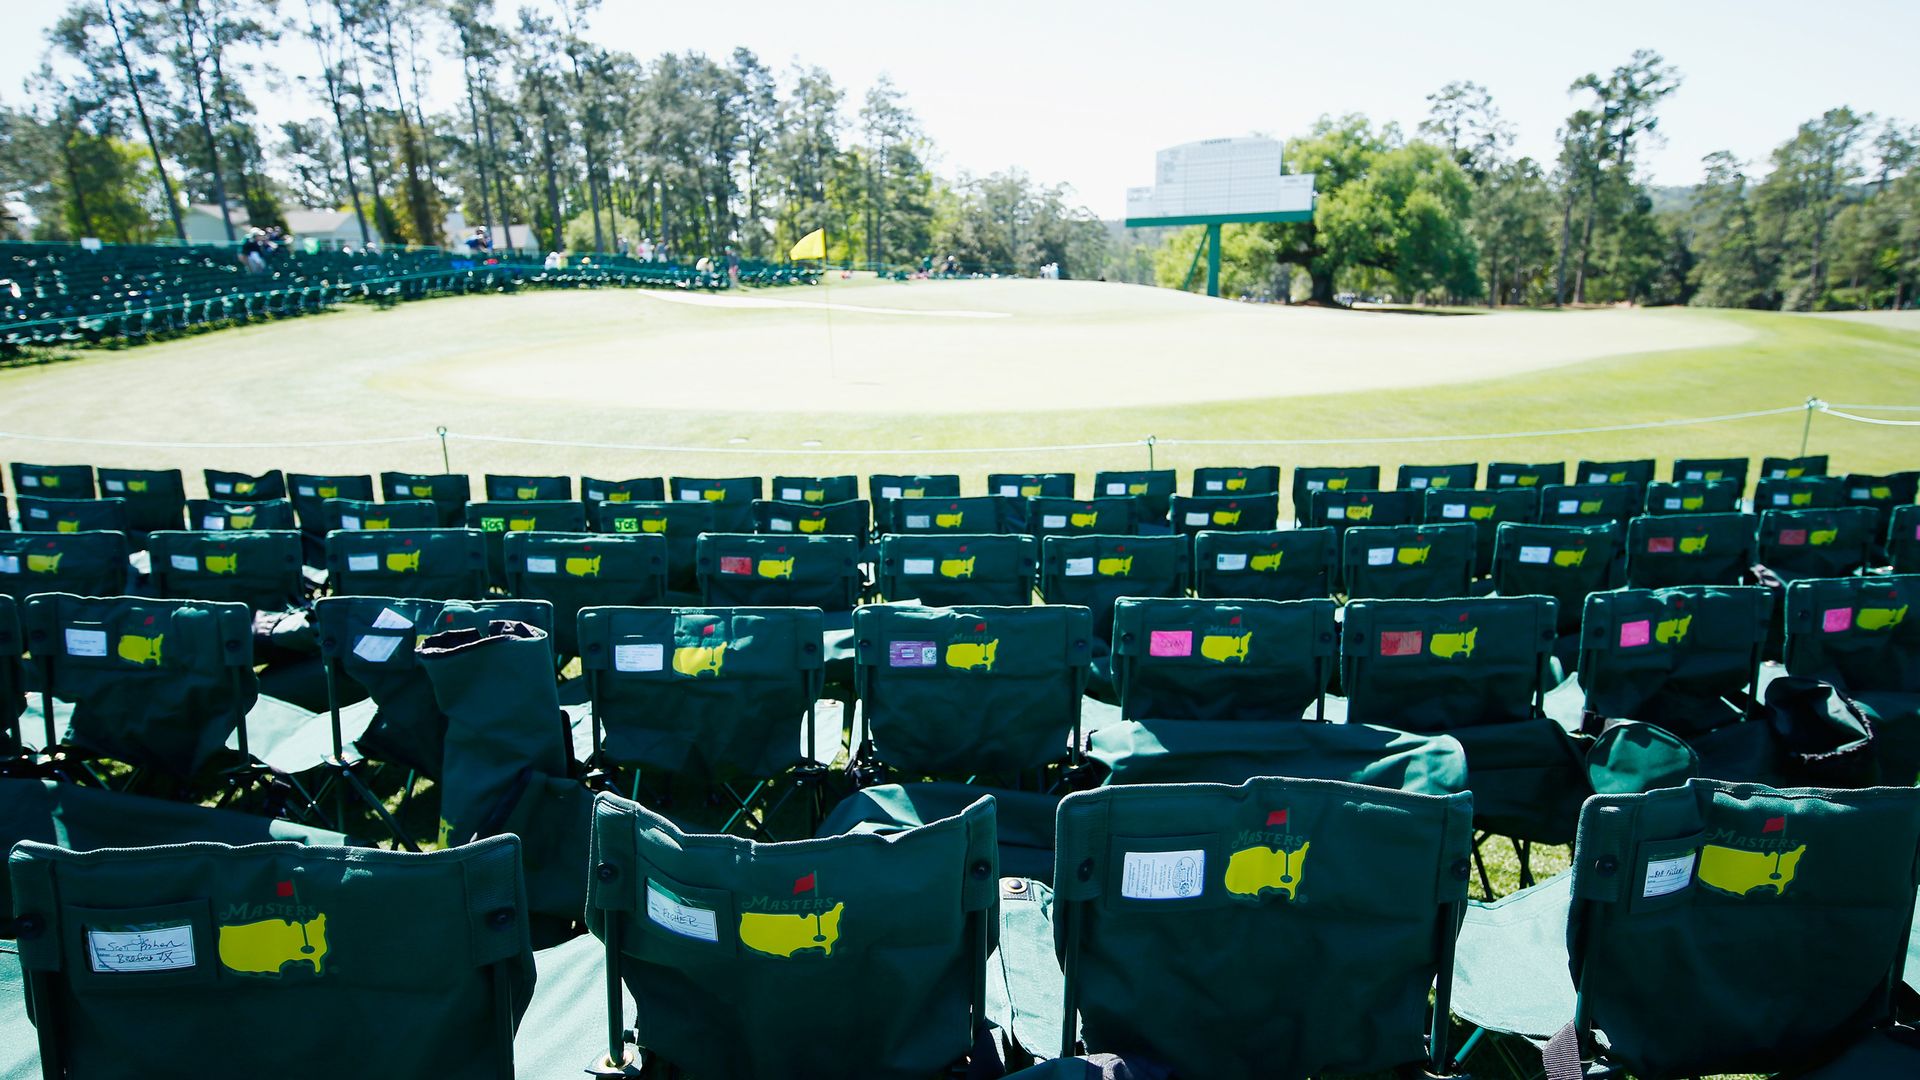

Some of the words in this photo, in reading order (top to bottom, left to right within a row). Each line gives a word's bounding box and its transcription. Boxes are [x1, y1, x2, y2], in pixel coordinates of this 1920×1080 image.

[1231, 830, 1304, 849] MASTERS
[219, 902, 316, 921] MASTERS
[741, 895, 834, 911] MASTERS
